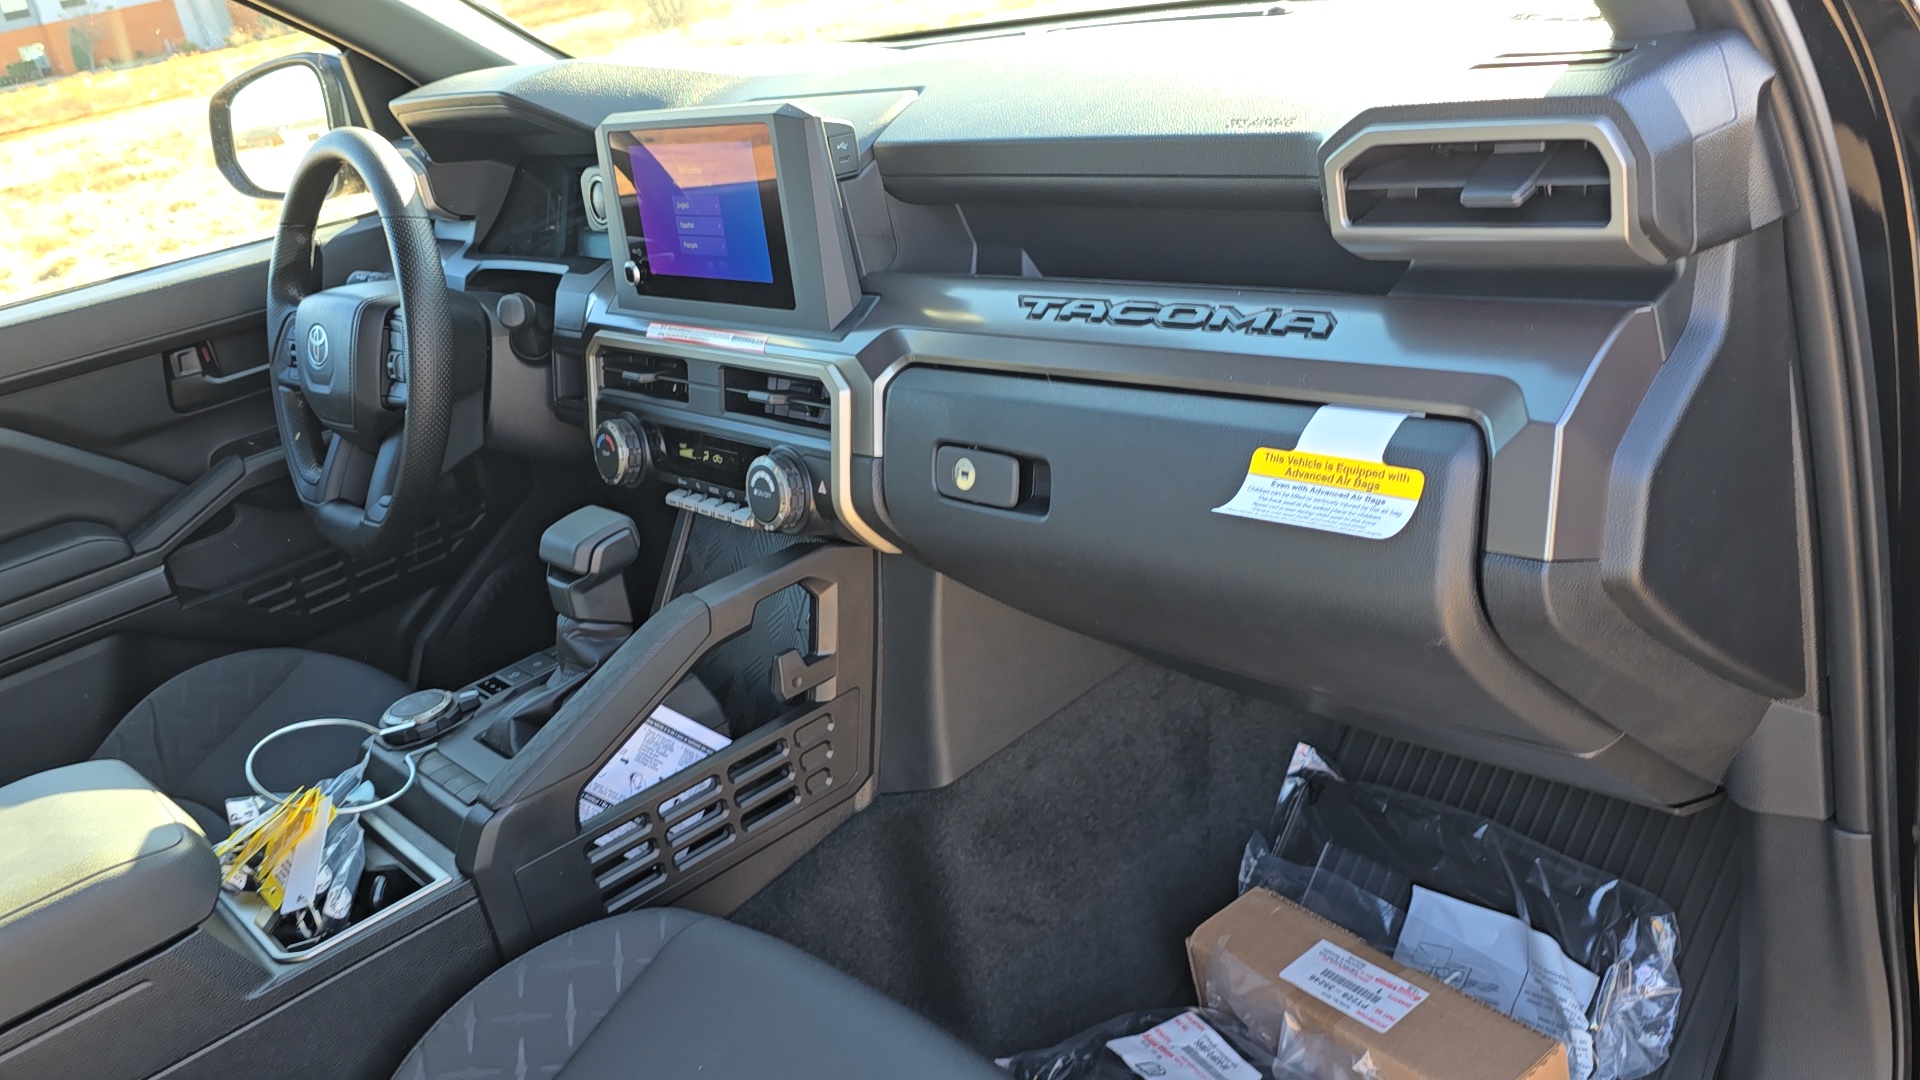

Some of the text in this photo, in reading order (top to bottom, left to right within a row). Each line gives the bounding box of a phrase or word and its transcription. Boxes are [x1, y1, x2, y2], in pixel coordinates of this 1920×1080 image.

[1018, 294, 1338, 341] TACOMA
[1264, 452, 1285, 465] This
[1287, 455, 1323, 470] Vehicle
[1336, 462, 1386, 480] Equipped
[1388, 471, 1411, 484] with
[1284, 467, 1381, 493] Advanced Air Bags
[1270, 480, 1291, 490] Even
[1291, 483, 1309, 493] with
[1309, 485, 1350, 499] Advanced
[1350, 492, 1363, 502] Air
